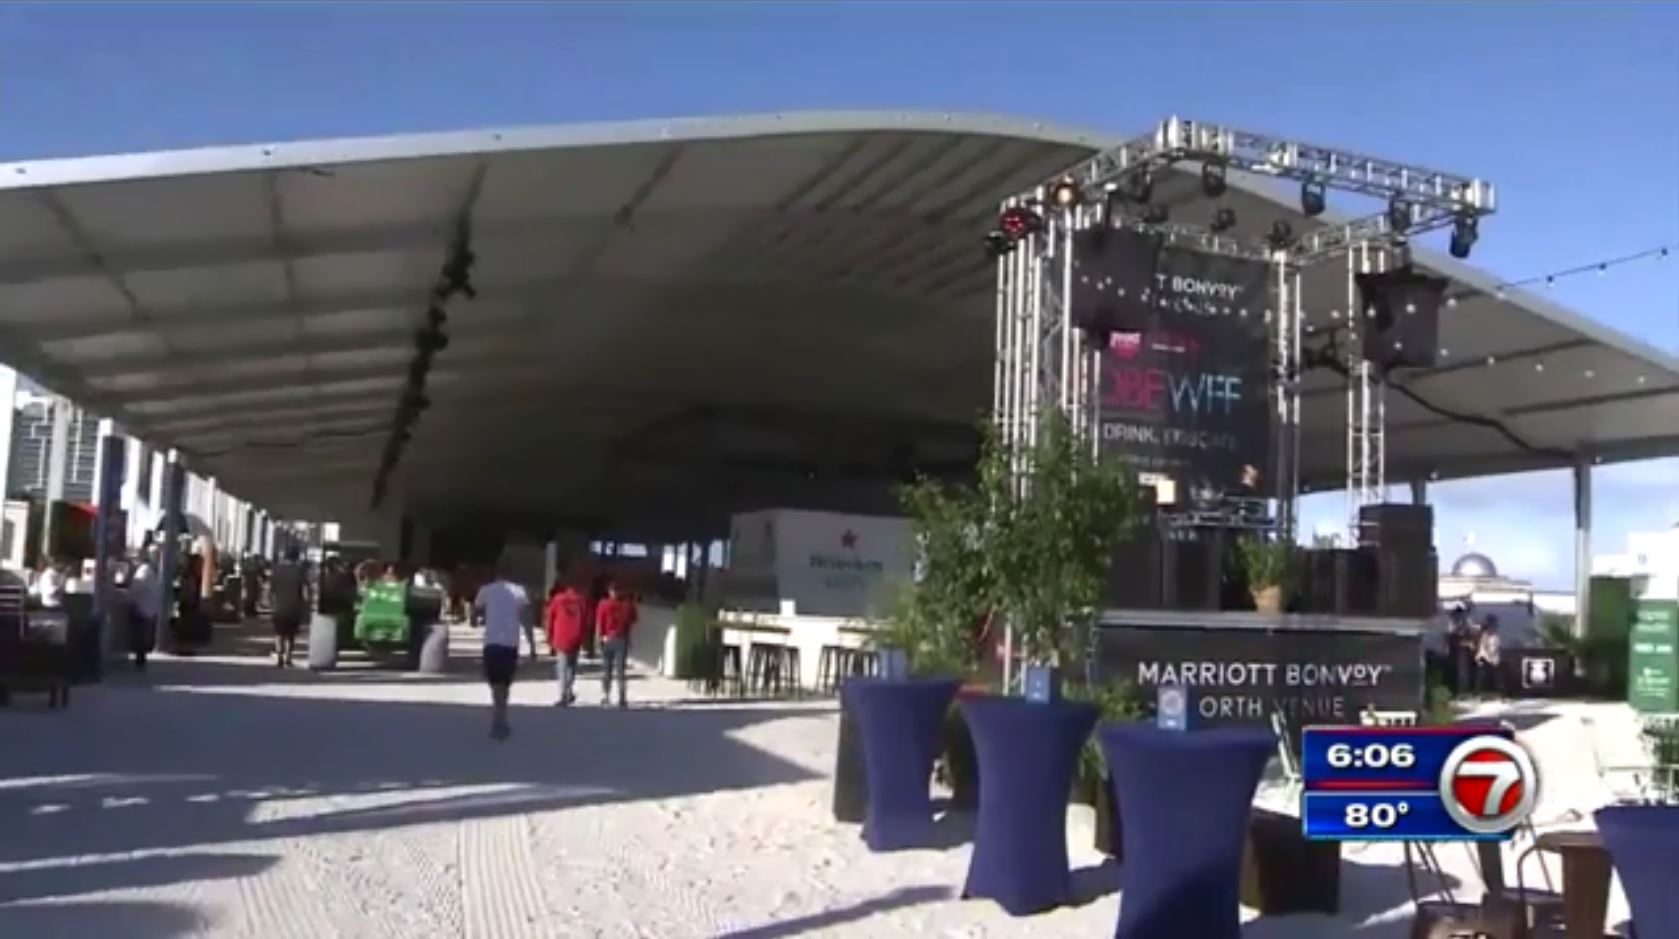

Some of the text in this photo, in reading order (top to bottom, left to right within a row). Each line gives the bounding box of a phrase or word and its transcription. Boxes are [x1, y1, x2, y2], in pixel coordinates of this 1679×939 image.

[1137, 661, 1383, 686] MARRIOTT BONVOY
[1199, 695, 1263, 718] ORTH
